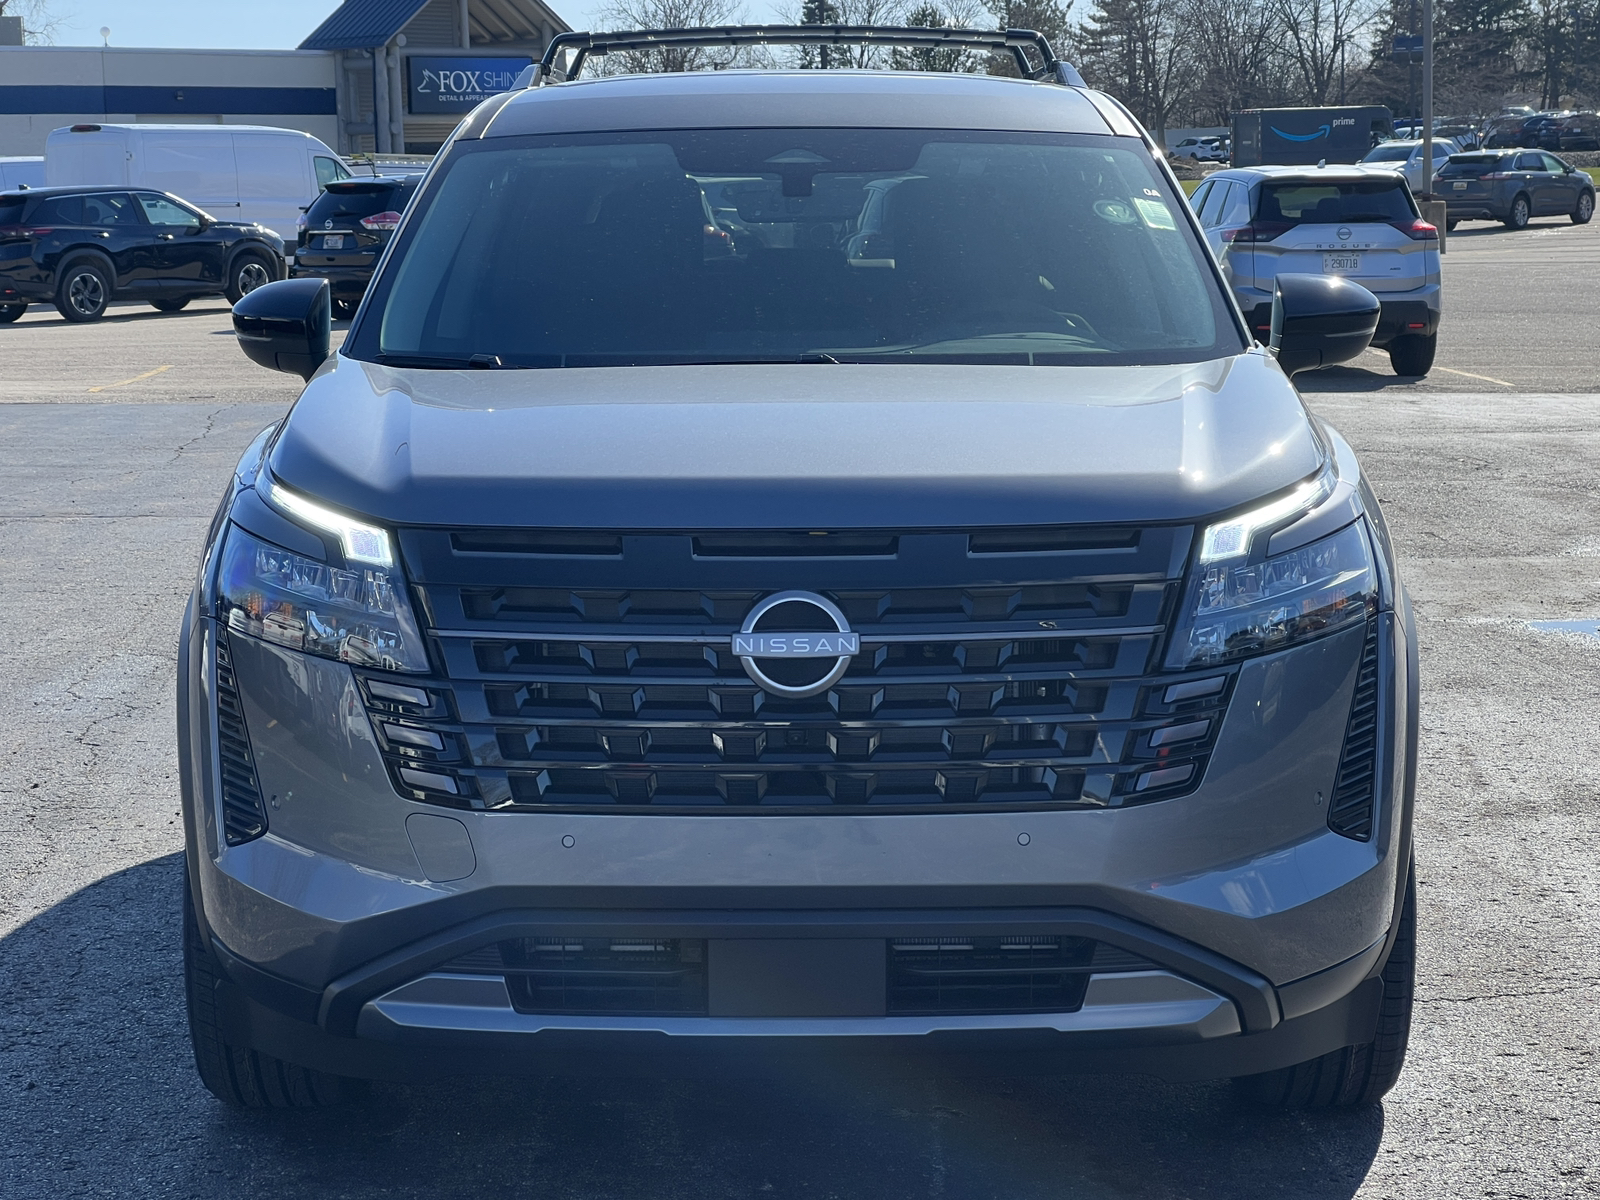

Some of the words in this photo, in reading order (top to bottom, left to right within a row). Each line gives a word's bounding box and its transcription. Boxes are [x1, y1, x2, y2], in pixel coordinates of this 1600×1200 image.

[438, 71, 482, 92] FOX
[1332, 117, 1355, 127] prime
[1331, 258, 1358, 268] 290718
[736, 637, 856, 652] NISSAN
